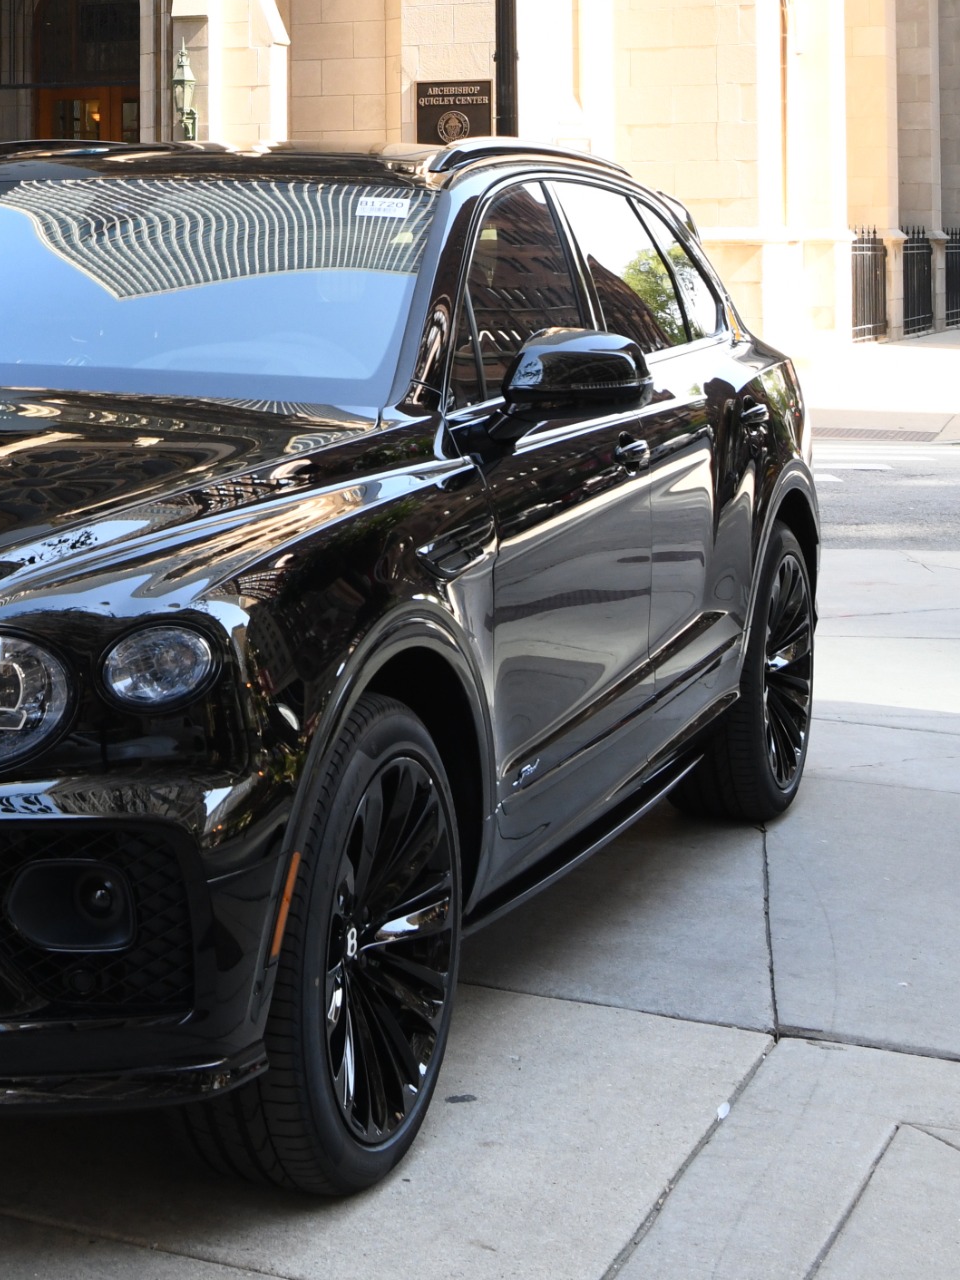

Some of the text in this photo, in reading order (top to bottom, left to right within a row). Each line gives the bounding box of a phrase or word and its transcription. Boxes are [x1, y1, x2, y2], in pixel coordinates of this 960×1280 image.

[427, 86, 480, 95] ARCHBISHOP
[418, 96, 489, 106] QUIGLEY CENTER
[347, 928, 357, 956] B
